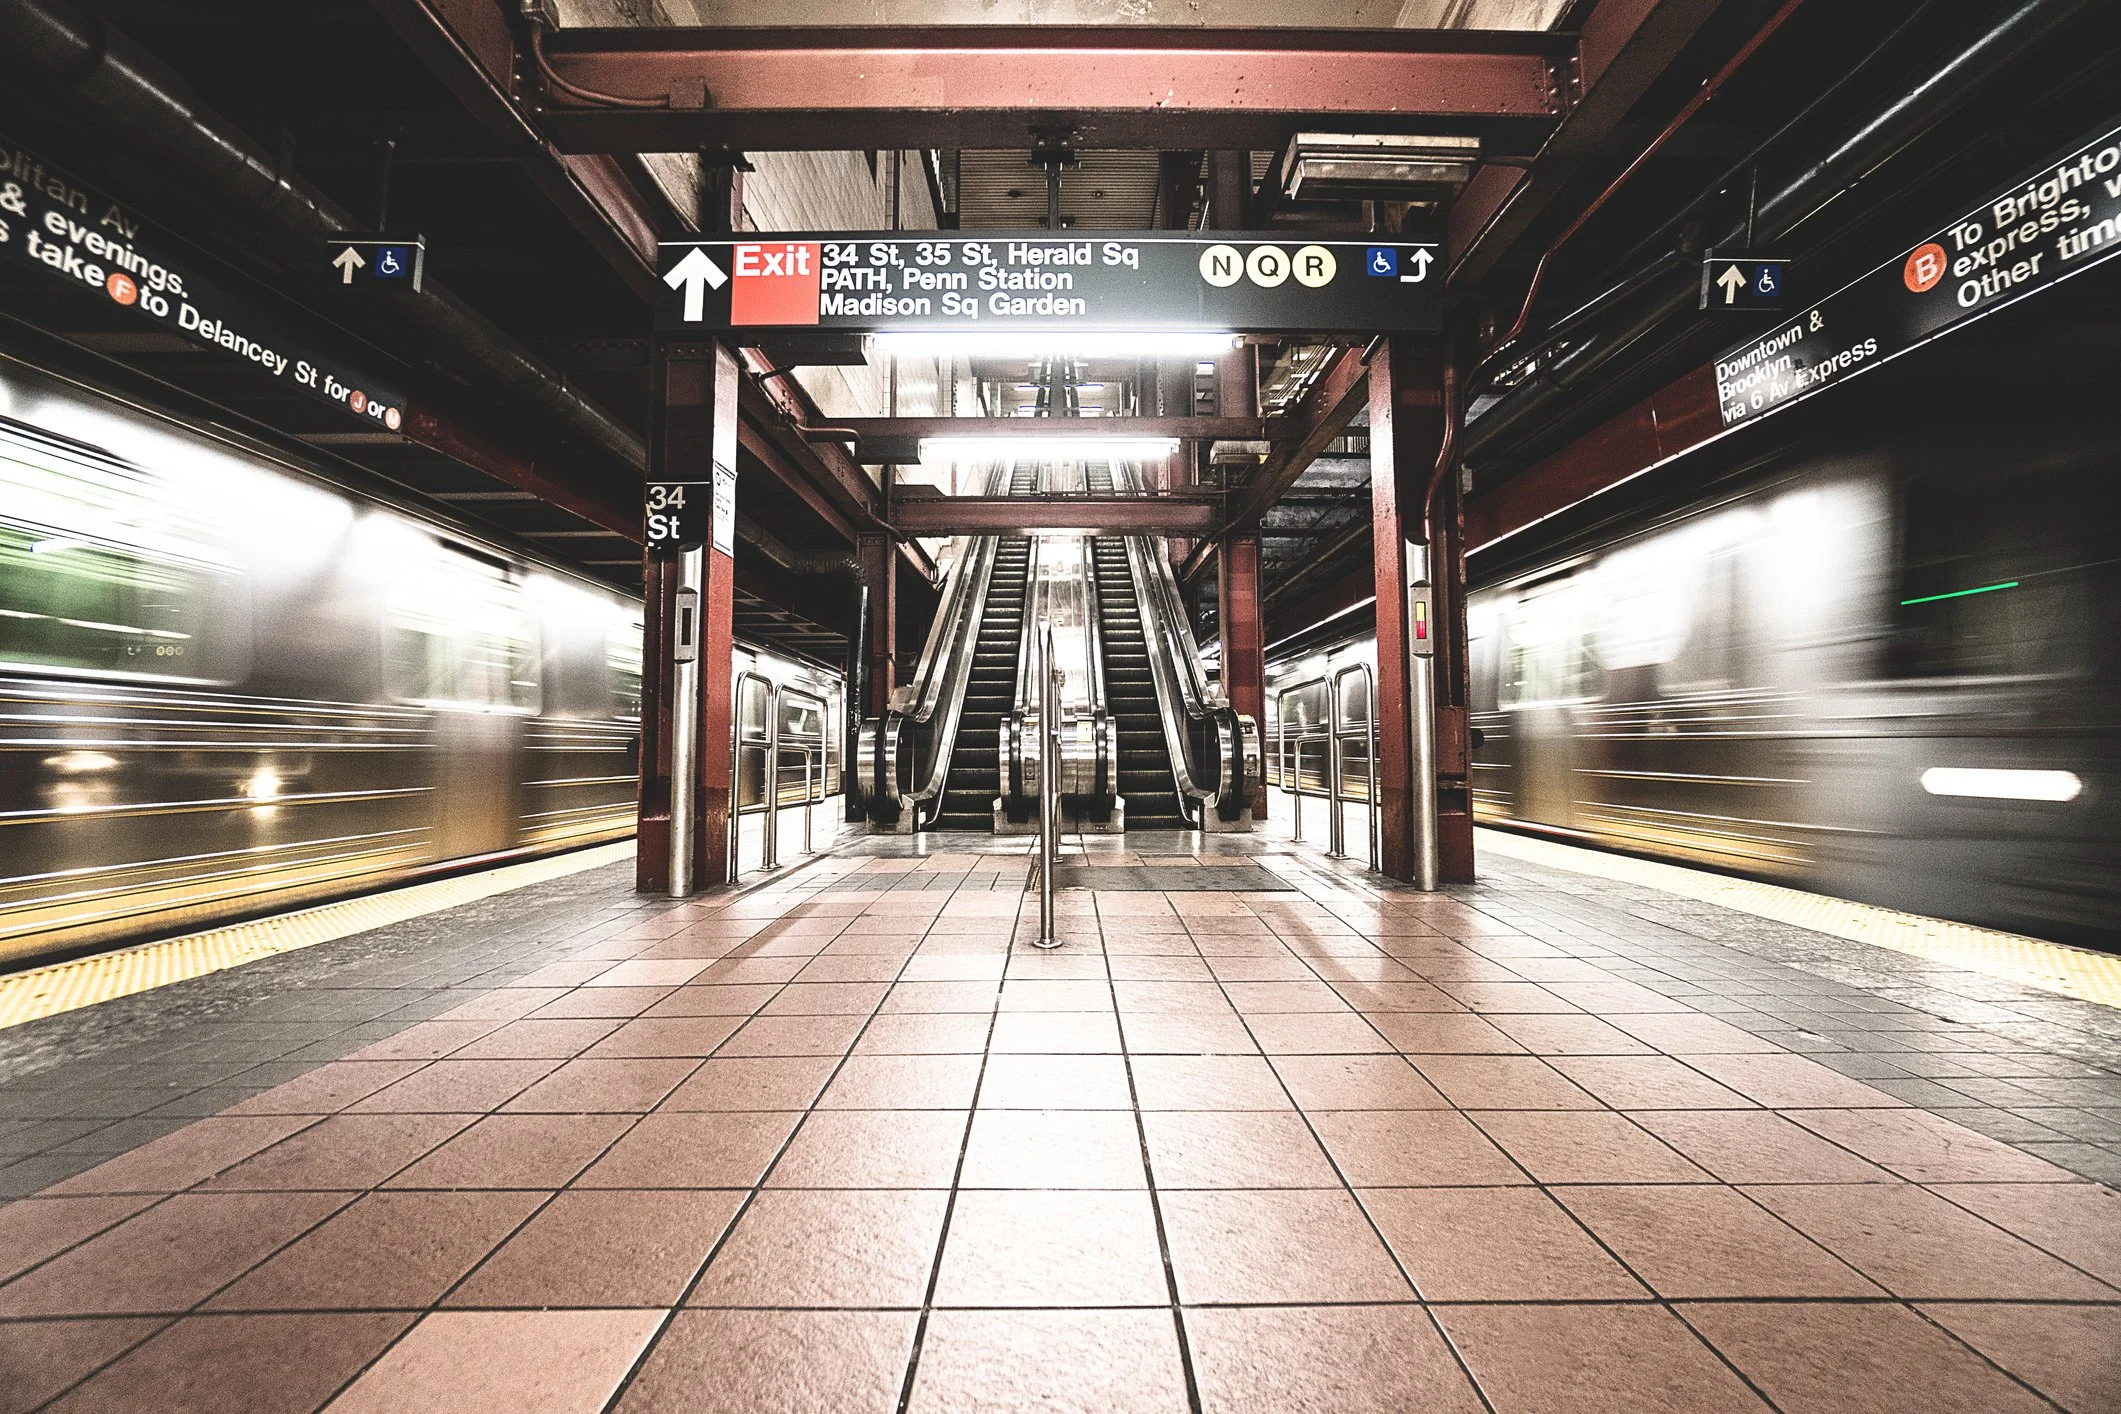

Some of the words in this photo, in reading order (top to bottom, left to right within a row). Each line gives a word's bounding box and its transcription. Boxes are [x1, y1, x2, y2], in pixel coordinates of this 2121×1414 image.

[1947, 222, 1984, 252] To
[1992, 140, 2121, 230] Brighto
[0, 181, 28, 218] &
[44, 210, 189, 299] evenings.
[99, 205, 140, 240] Av
[1953, 197, 2092, 278] express,
[735, 245, 811, 277] Exit
[822, 244, 858, 265] 34
[869, 243, 905, 269] St,
[915, 244, 951, 265] 35
[961, 243, 998, 269] St,
[1007, 243, 1092, 266] Herald
[1102, 243, 1139, 269] Sq
[1211, 254, 1232, 277] N
[1256, 254, 1280, 278] Q
[1305, 254, 1324, 277] R
[1914, 252, 1939, 286] B
[1957, 252, 2044, 309] Other
[2056, 212, 2121, 261] tim
[821, 268, 893, 295] PATH,
[903, 268, 967, 290] Penn
[978, 267, 1073, 290] Station
[820, 293, 931, 316] Madison
[941, 293, 978, 319] Sq
[988, 293, 1086, 316] Garden
[26, 229, 106, 288] take
[139, 284, 170, 317] to
[178, 303, 288, 376] Delancey
[294, 362, 318, 390] St
[324, 375, 351, 402] for
[367, 401, 386, 419] or
[1717, 325, 1803, 383] Downtown
[1809, 309, 1825, 333] &
[1719, 354, 1792, 402] Brooklyn
[1723, 402, 1746, 423] via
[1750, 392, 1764, 410] 6
[1769, 381, 1789, 403] Av
[1795, 337, 1878, 389] Express
[648, 485, 686, 510] 34
[647, 514, 680, 540] St
